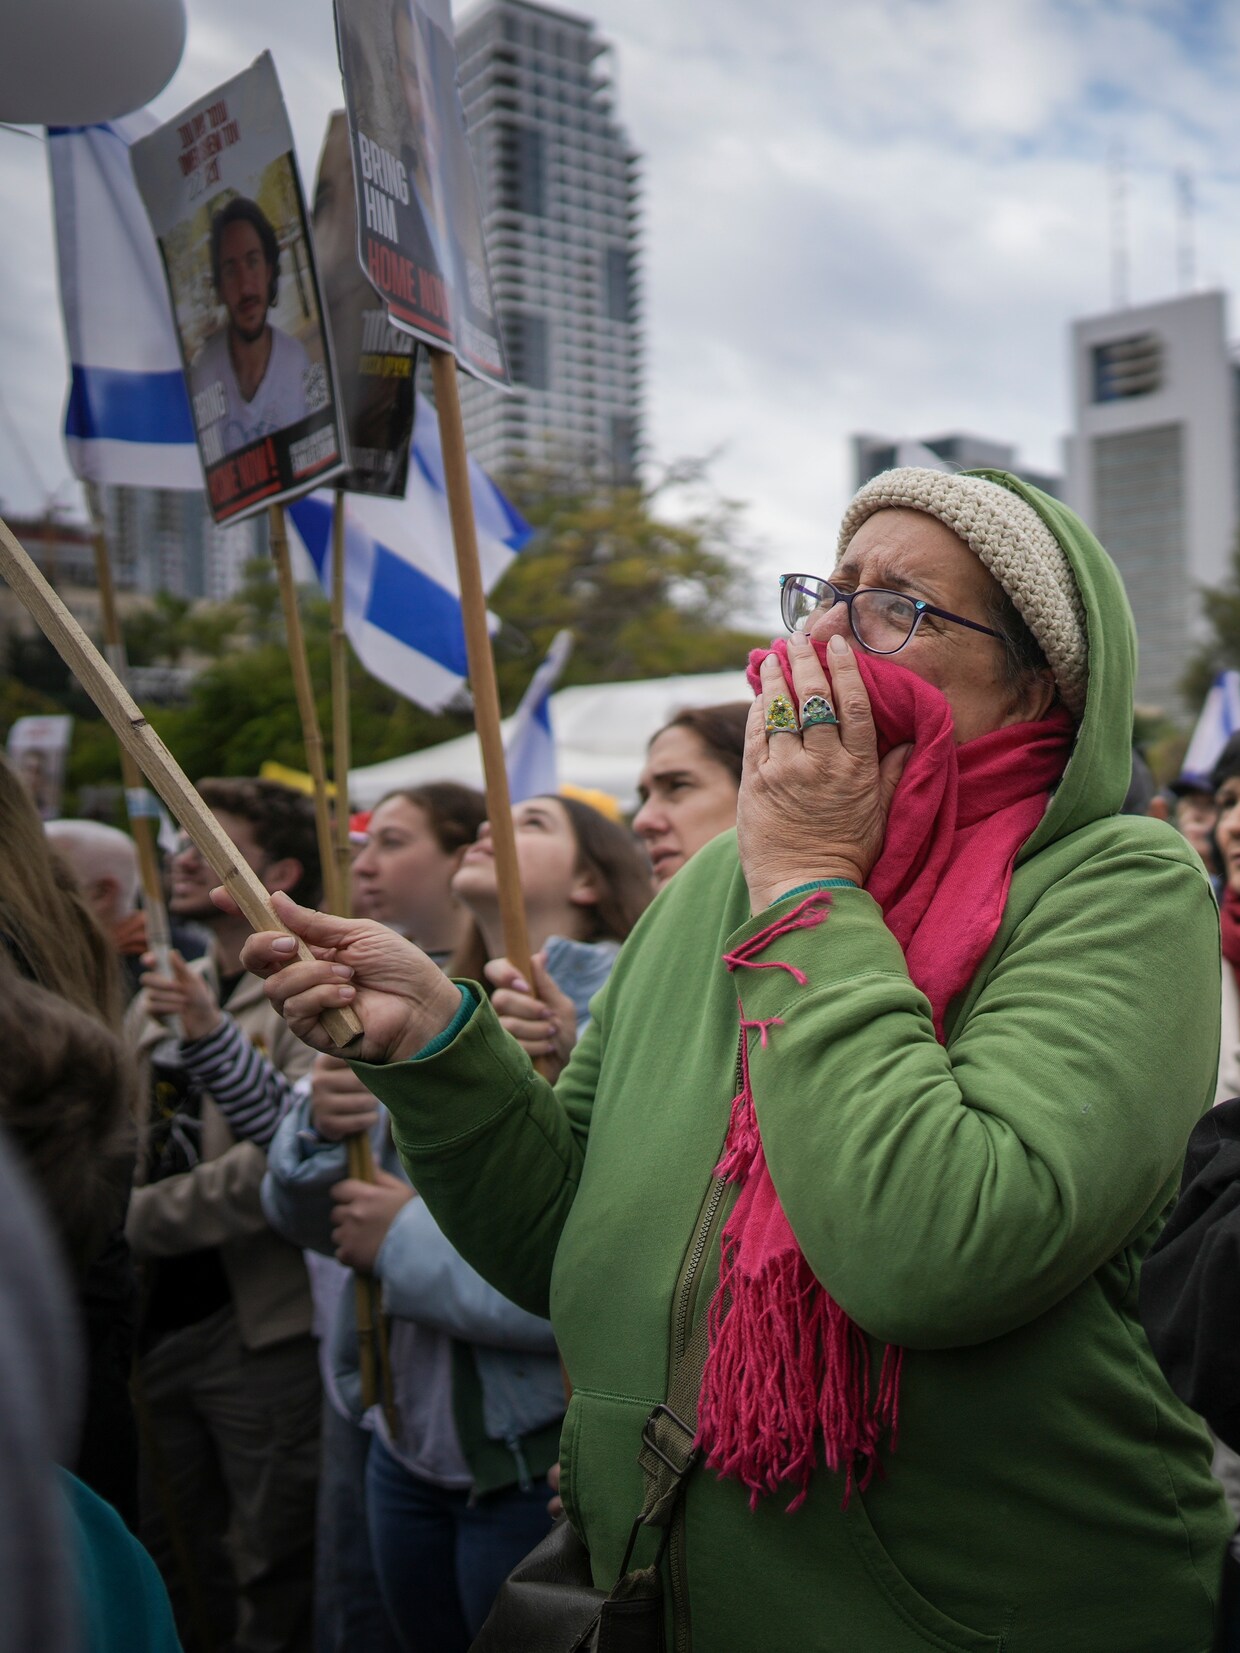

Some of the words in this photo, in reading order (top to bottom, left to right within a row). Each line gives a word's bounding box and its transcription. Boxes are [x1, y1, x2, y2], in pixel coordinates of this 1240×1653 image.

[358, 131, 409, 206] BRING
[364, 182, 398, 244] HIM
[367, 238, 416, 304] HOME
